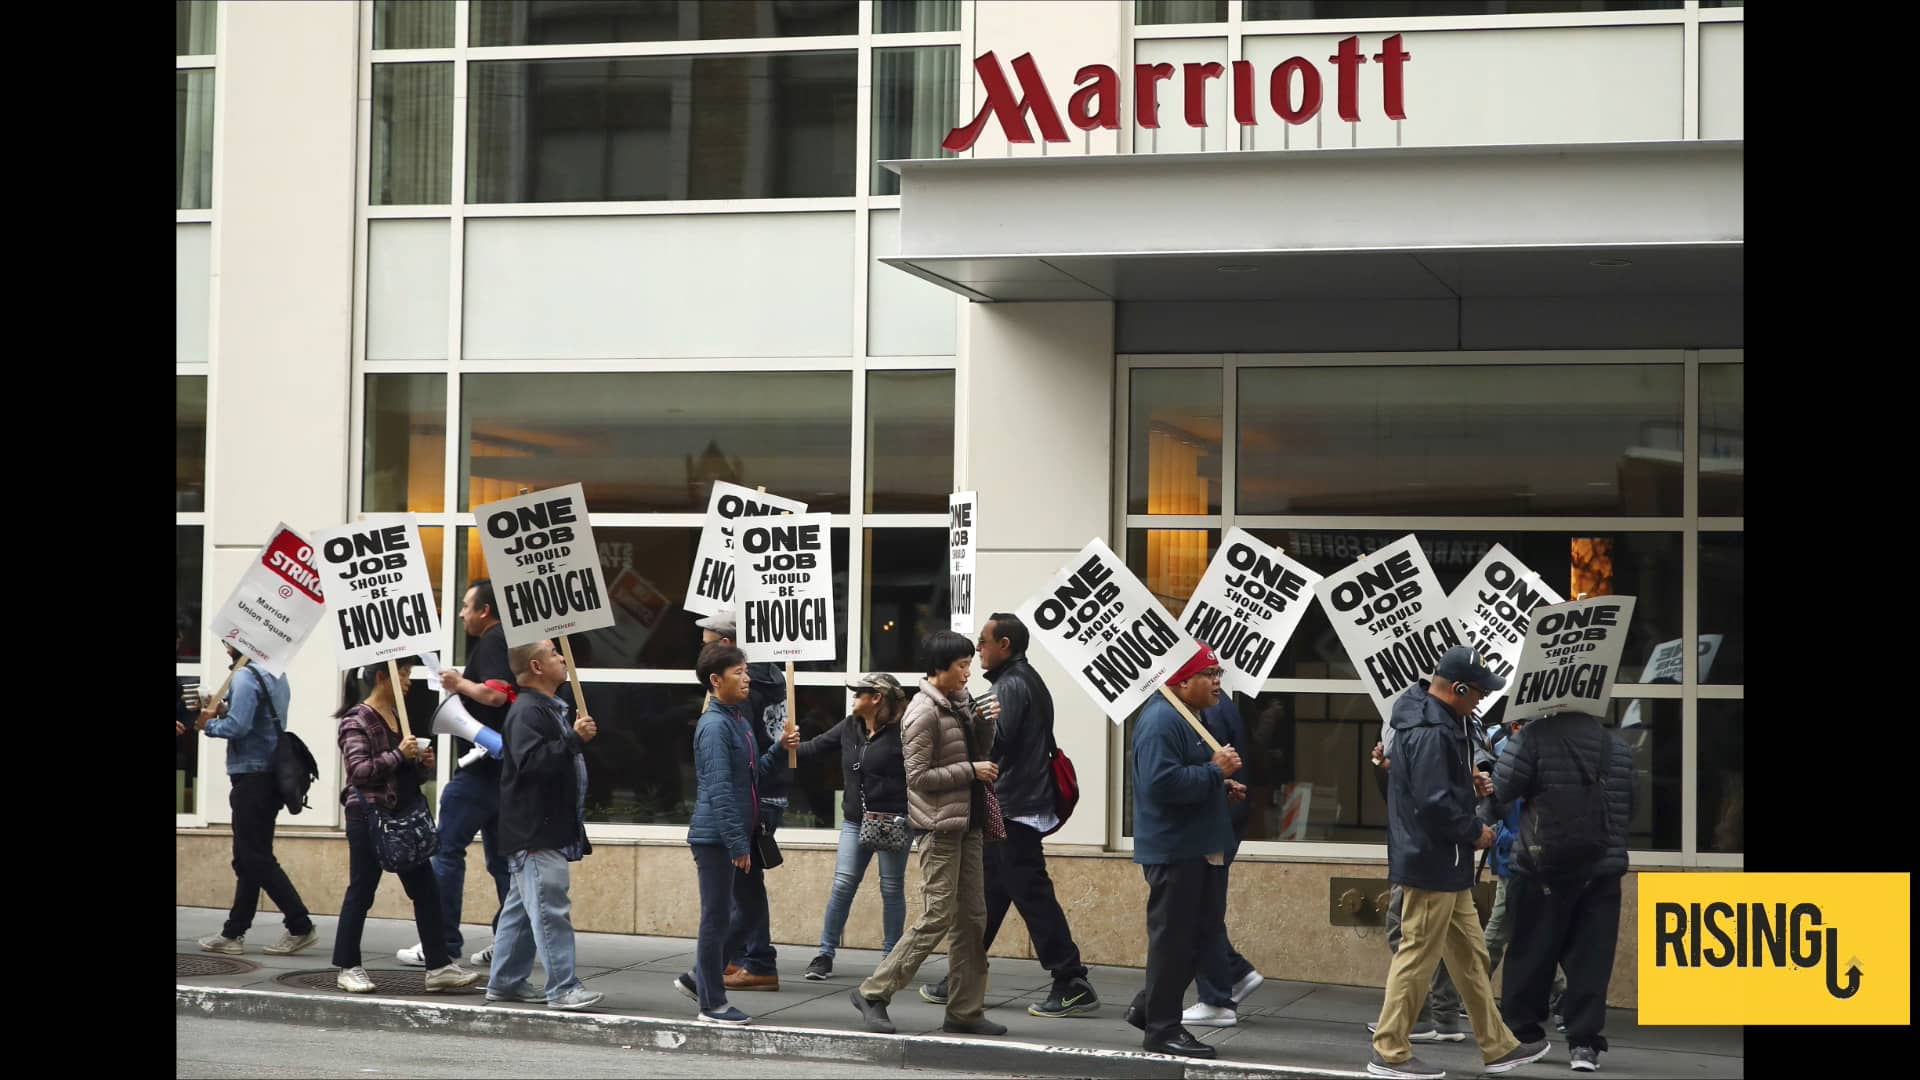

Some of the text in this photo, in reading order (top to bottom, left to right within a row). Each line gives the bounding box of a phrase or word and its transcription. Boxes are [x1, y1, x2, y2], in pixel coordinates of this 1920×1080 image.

[942, 33, 1411, 152] Marriott
[487, 497, 577, 539] ONE
[323, 525, 410, 563] ONE
[504, 526, 575, 554] JOB
[743, 524, 821, 554] ONE
[339, 553, 407, 579] JOB
[515, 546, 571, 567] SHOULD
[537, 562, 556, 575] BE
[753, 553, 816, 572] JOB
[1226, 543, 1307, 601] ONE
[350, 572, 403, 591] SHOULD
[371, 587, 388, 599] BE
[761, 572, 811, 585] SHOULD
[778, 586, 794, 597] BE
[1034, 554, 1114, 630] ONE
[1225, 573, 1287, 613] JOB
[1331, 550, 1420, 612] ONE
[256, 597, 290, 624] Marriott
[504, 567, 601, 627] ENOUGH
[1063, 581, 1121, 640] JOB
[1224, 588, 1272, 620] SHOULD
[1354, 580, 1422, 625] JOB
[238, 601, 293, 642] Union Square
[337, 592, 431, 650] ENOUGH
[745, 597, 827, 643] ENOUGH
[1077, 601, 1124, 645] SHOULD
[1234, 607, 1251, 623] BE
[1368, 601, 1422, 636] SHOULD
[1392, 620, 1412, 638] BE
[1474, 604, 1518, 644] SHOULD
[1536, 605, 1621, 636] ONE
[1101, 623, 1120, 642] BE
[1184, 600, 1276, 677] ENOUGH
[1480, 625, 1497, 641] BE
[1539, 628, 1607, 649] JOB
[1082, 607, 1180, 703] ENOUGH
[1364, 617, 1462, 699] ENOUGH
[1544, 643, 1596, 659] SHOULD
[1559, 657, 1575, 666] BE
[1514, 663, 1608, 705] ENOUGH
